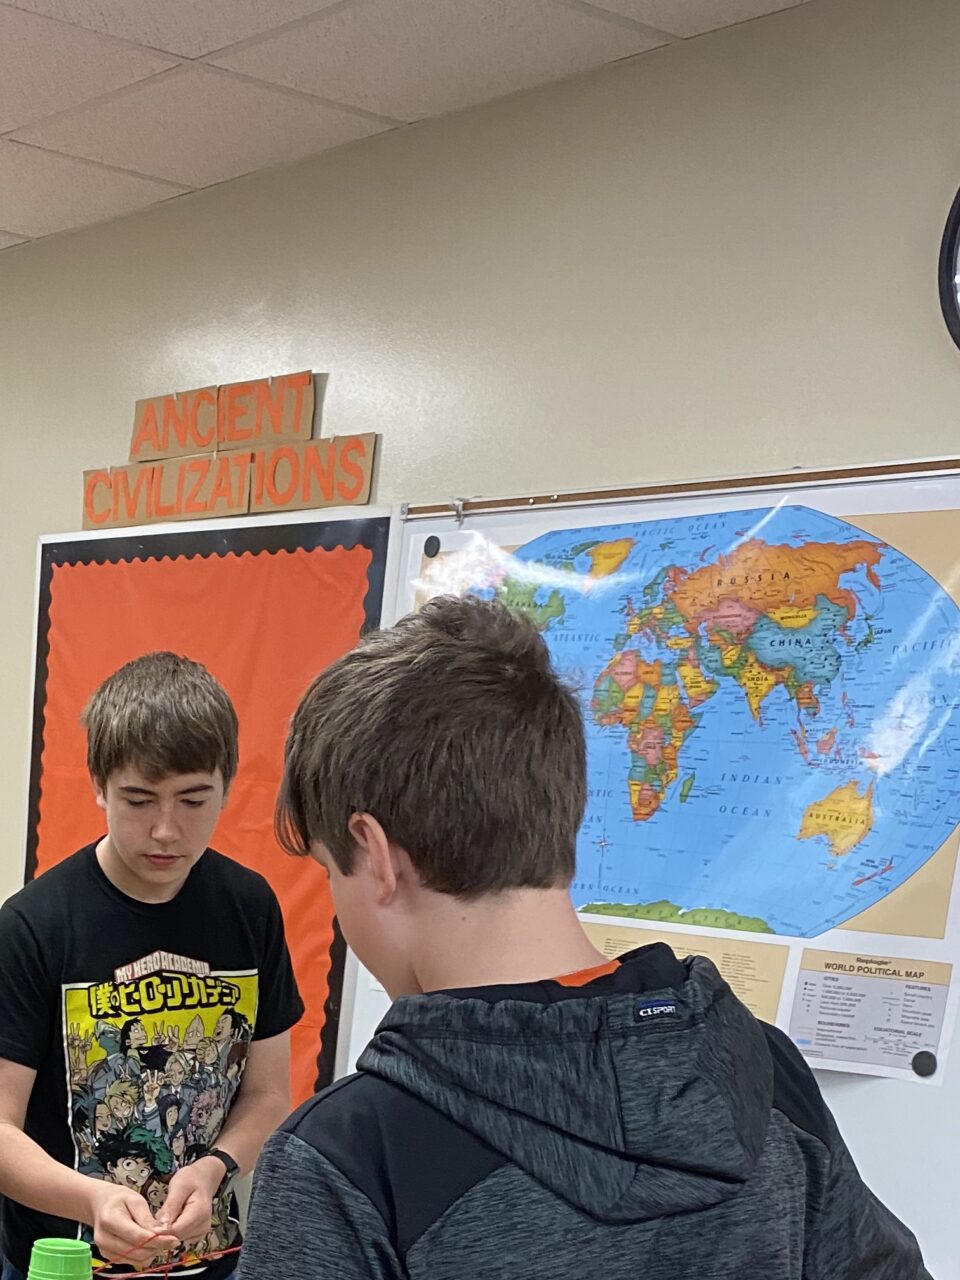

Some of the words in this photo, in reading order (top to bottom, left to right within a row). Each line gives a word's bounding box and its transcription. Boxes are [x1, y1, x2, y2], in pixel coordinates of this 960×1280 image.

[131, 373, 311, 455] ANCIENT
[84, 437, 366, 525] CIVILIZATIONS
[717, 572, 790, 586] RUSSIA
[554, 633, 600, 642] ATLANTIC
[770, 638, 811, 647] CHINA
[720, 773, 783, 785] INDIAN
[719, 805, 772, 817] OCEAN
[808, 812, 865, 825] AUSTRALIA
[115, 964, 135, 983] MY
[134, 951, 161, 980] HERO
[161, 950, 210, 975] ACADEMIA
[824, 962, 855, 972] WORLD
[857, 965, 903, 977] POLITICAL
[905, 970, 925, 979] MAP
